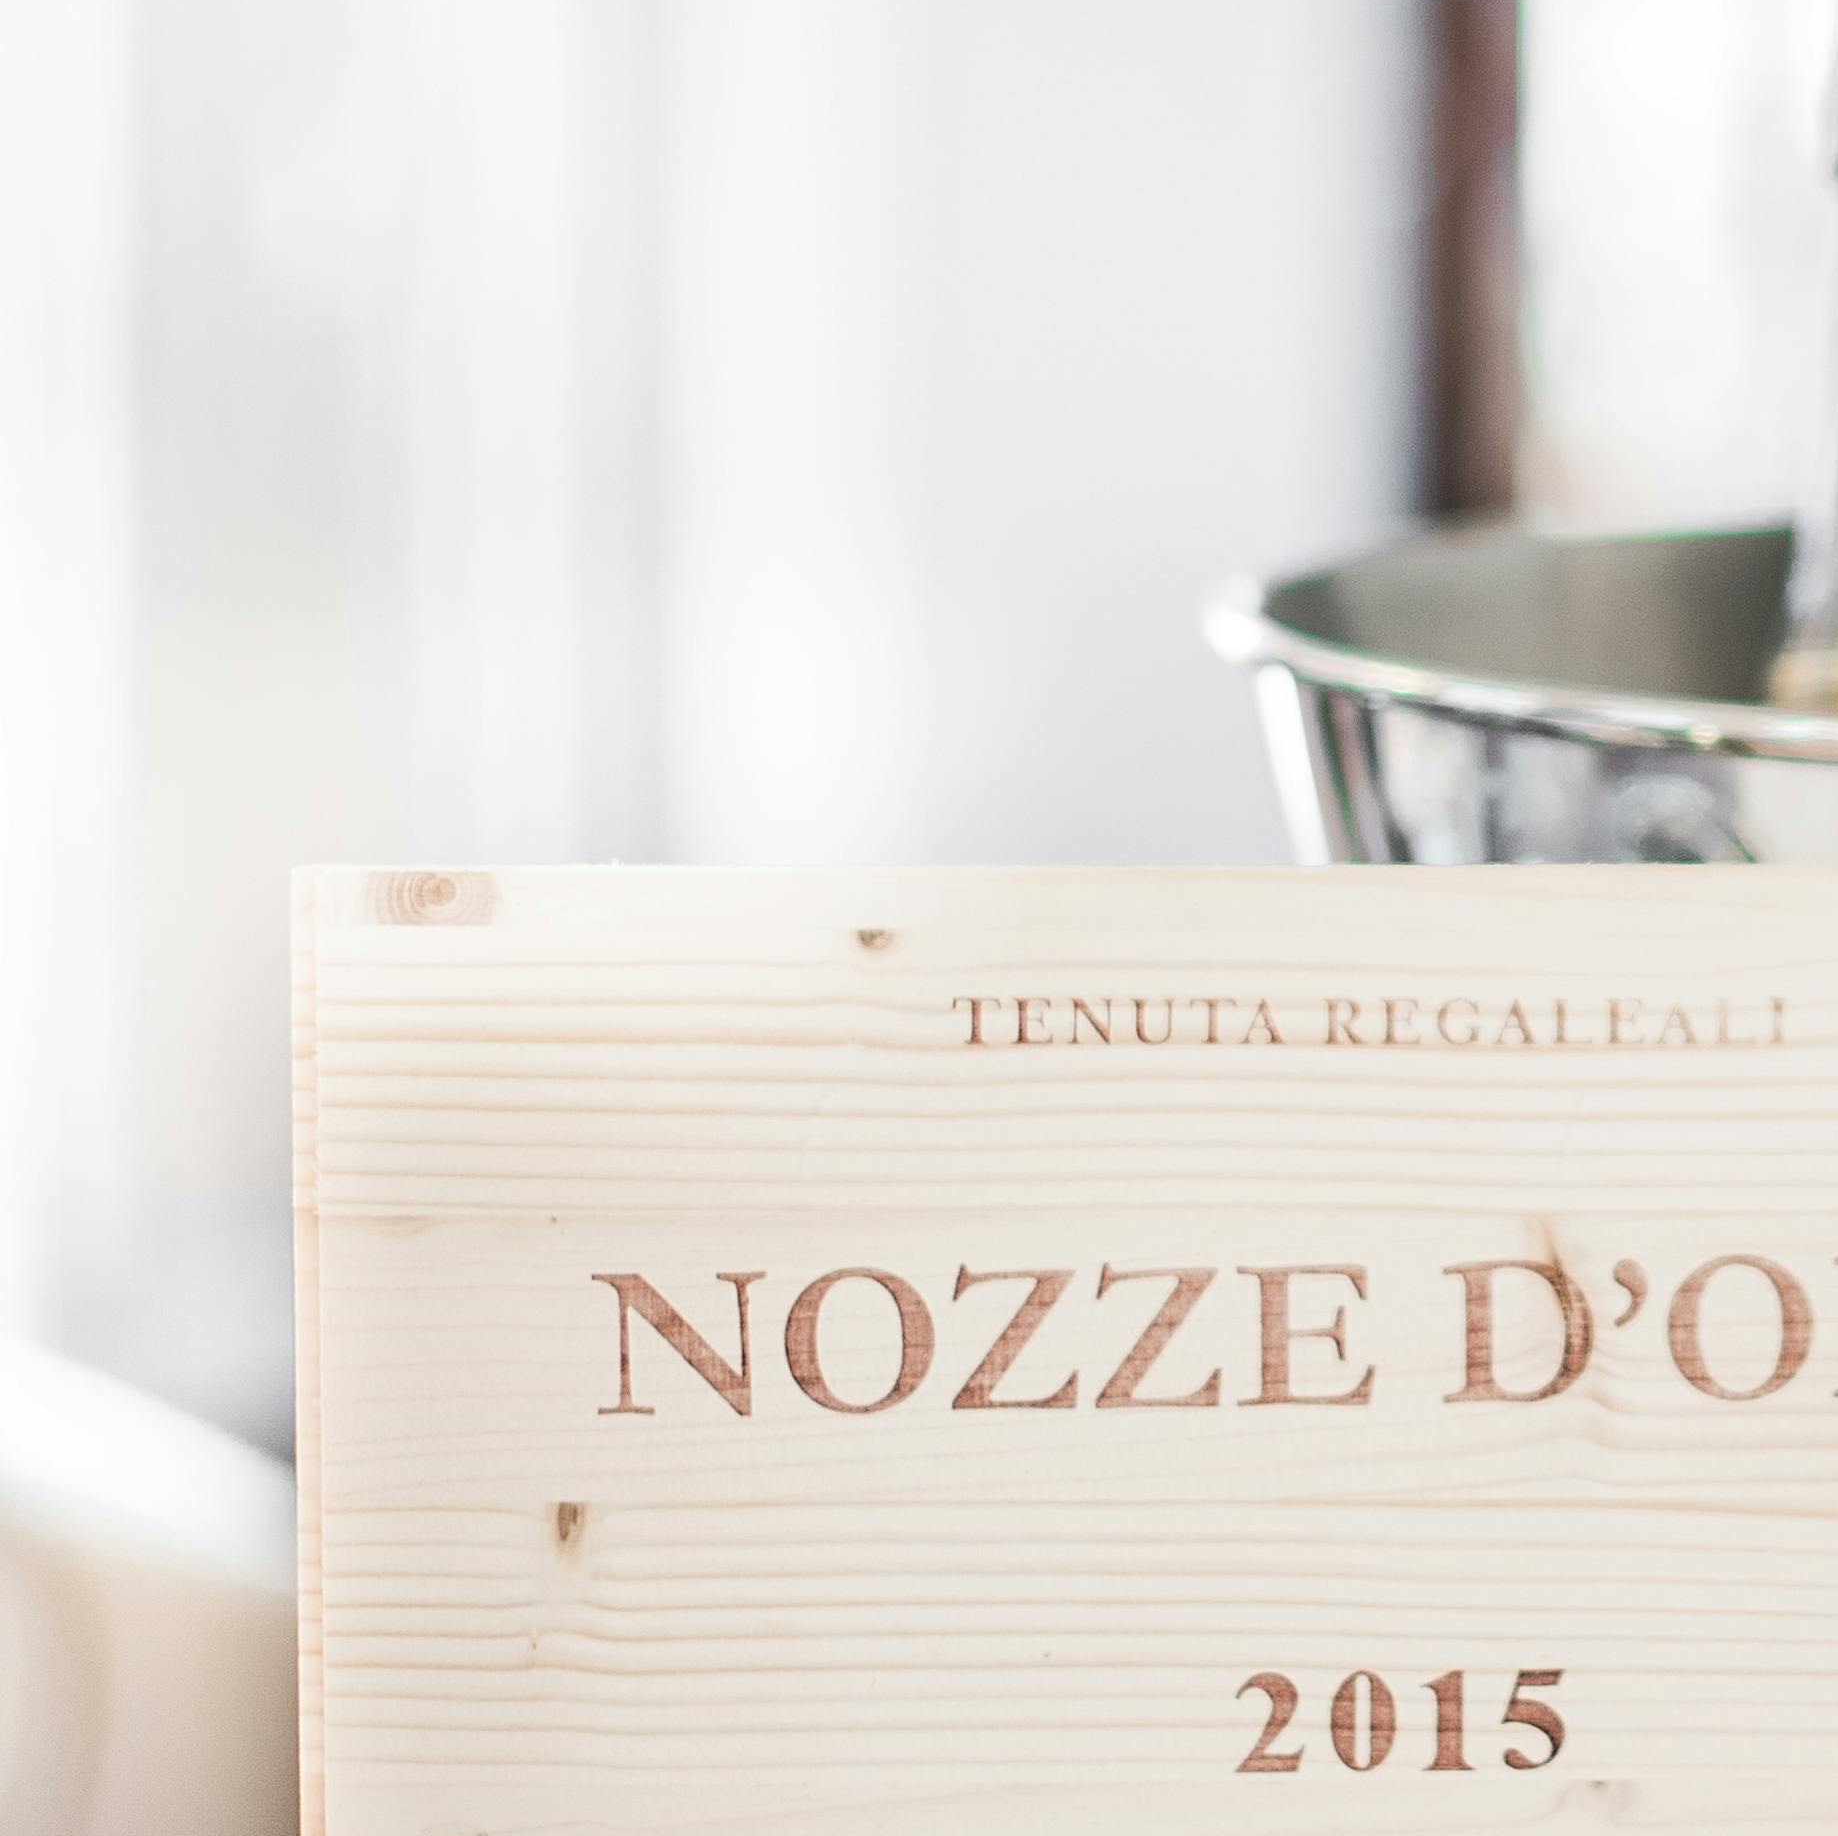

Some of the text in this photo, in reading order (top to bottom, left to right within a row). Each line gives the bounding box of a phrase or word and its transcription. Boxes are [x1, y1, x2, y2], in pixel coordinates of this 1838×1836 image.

[952, 995, 1790, 1046] TENUTA REGALEALI
[590, 1261, 1377, 1420] NOZZE
[1233, 1668, 1569, 1774] 2015
